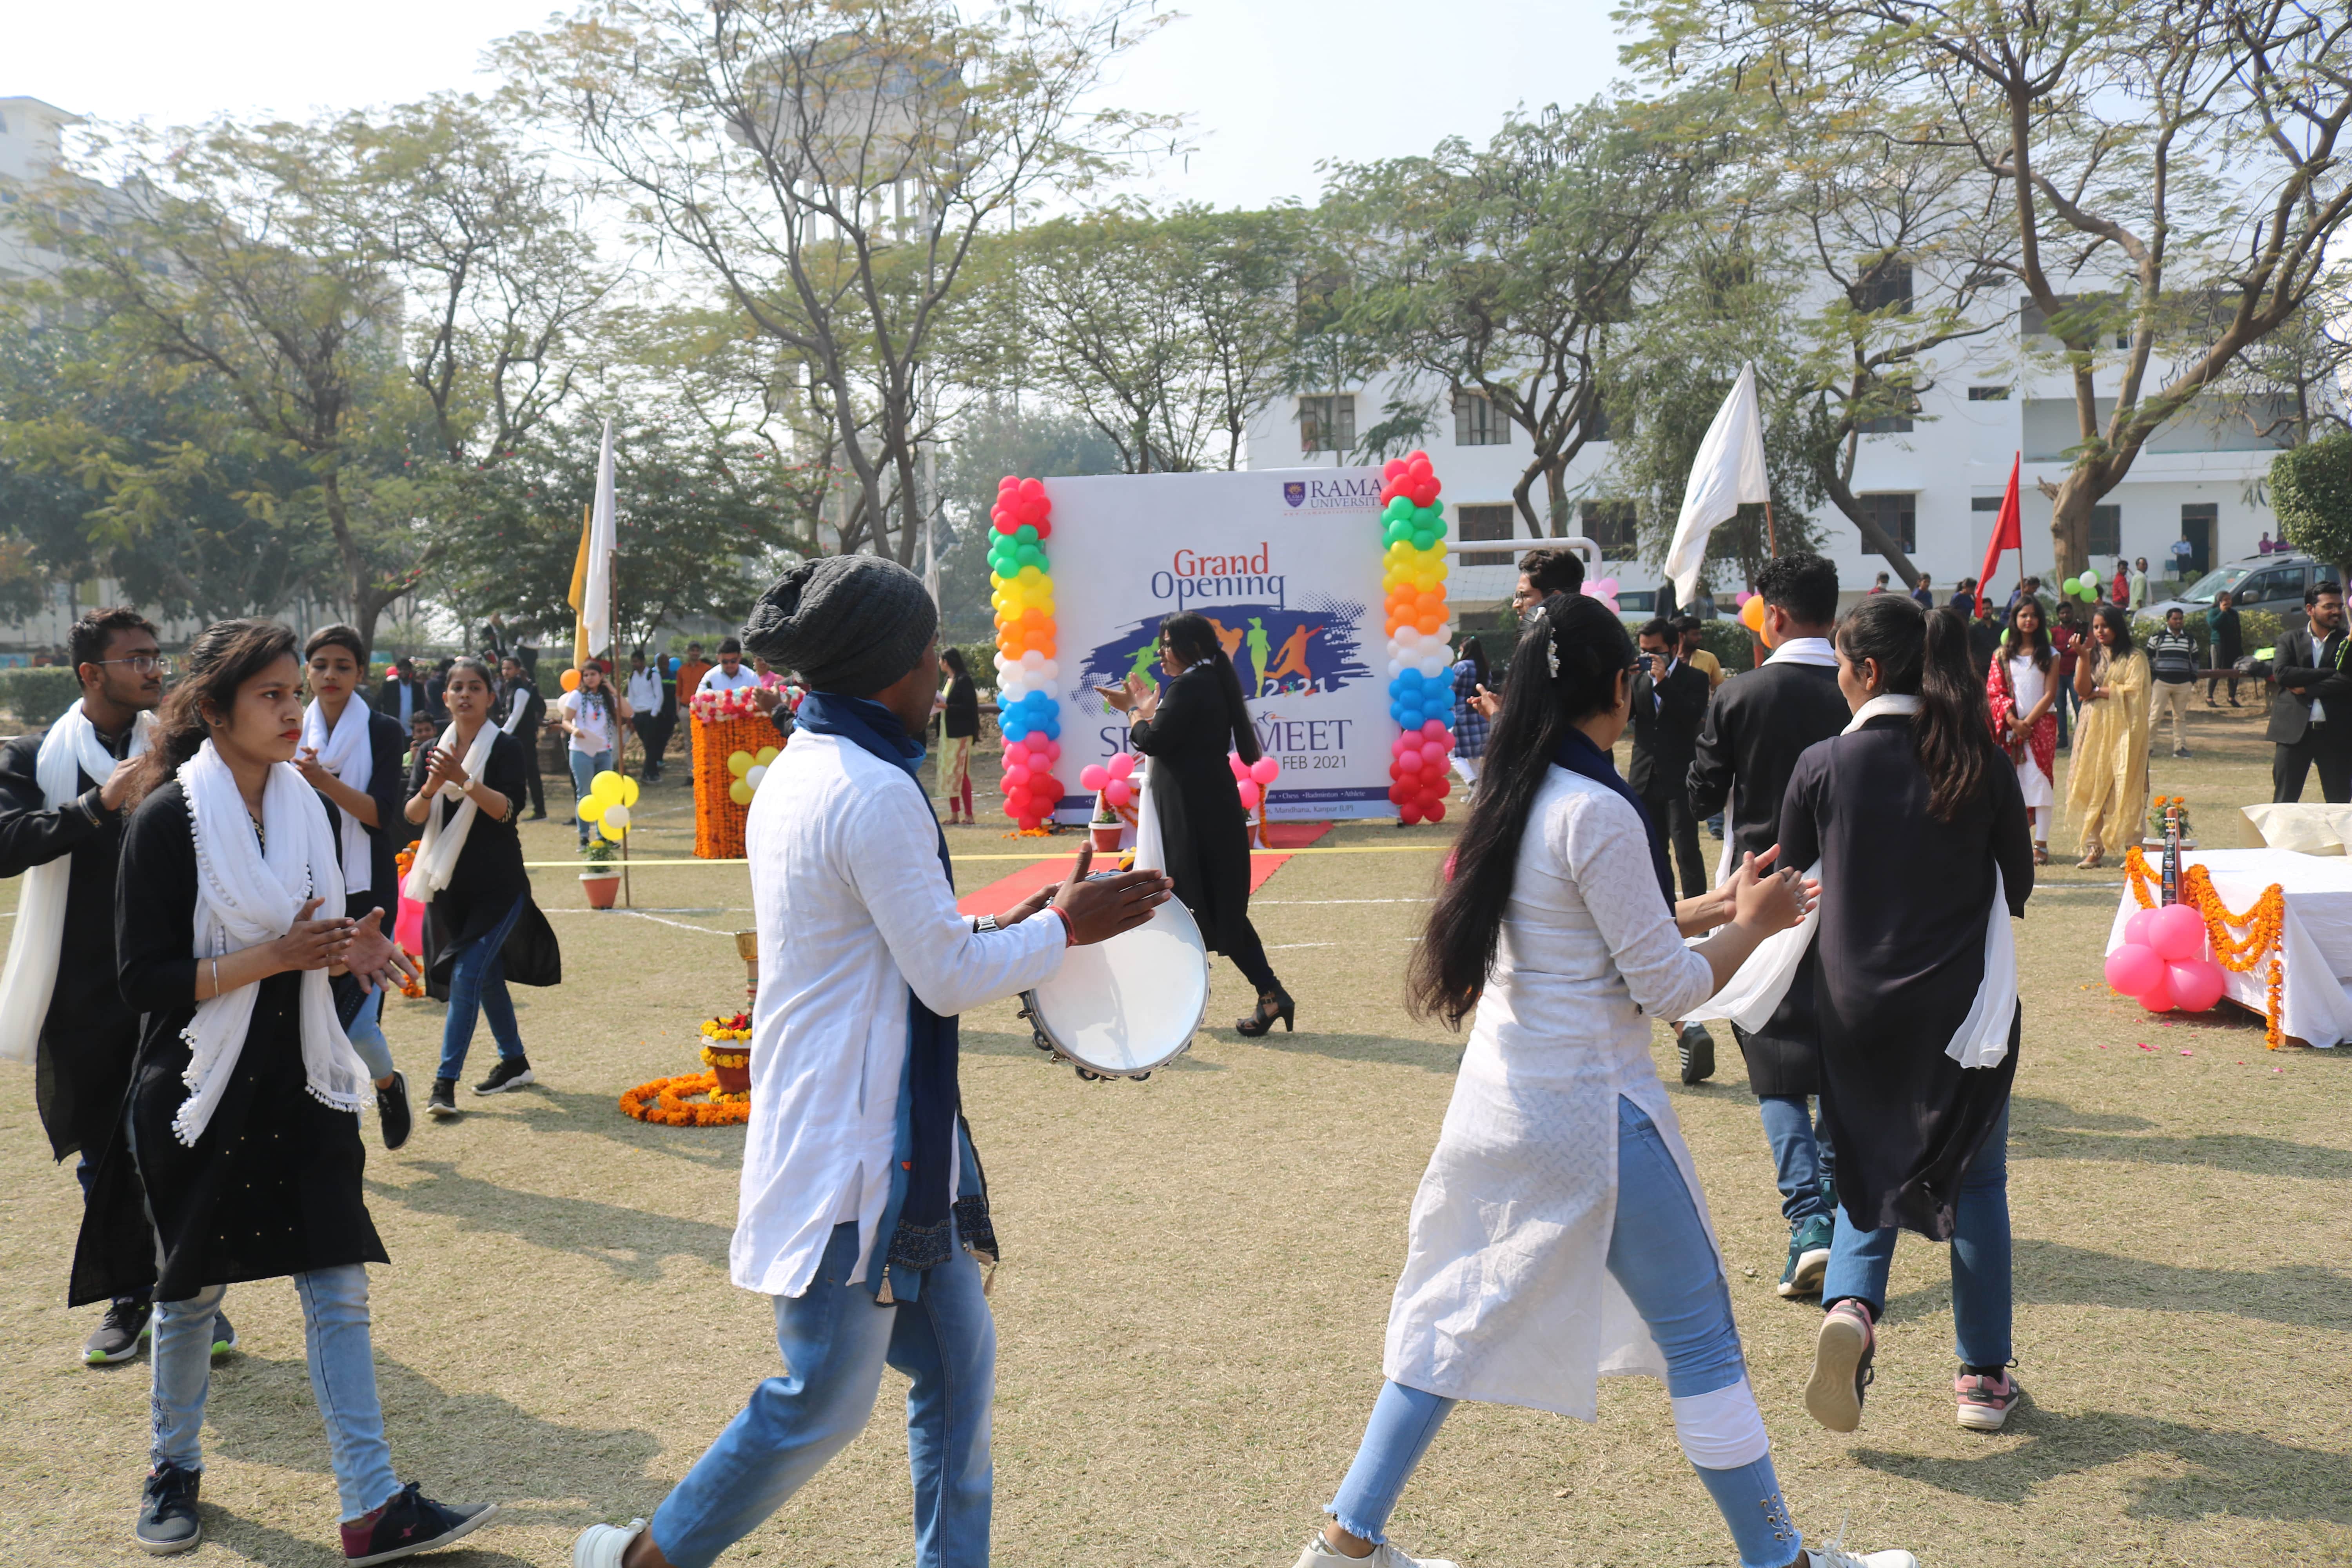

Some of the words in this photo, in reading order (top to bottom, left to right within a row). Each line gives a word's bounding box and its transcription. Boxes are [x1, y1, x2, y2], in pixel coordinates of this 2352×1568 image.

[1310, 479, 1382, 497] RAMA
[1174, 541, 1269, 577] Grand
[1151, 568, 1286, 612] Opening
[1253, 720, 1352, 752] MEET
[1283, 756, 1307, 769] FEB
[1313, 755, 1346, 769] 2021
